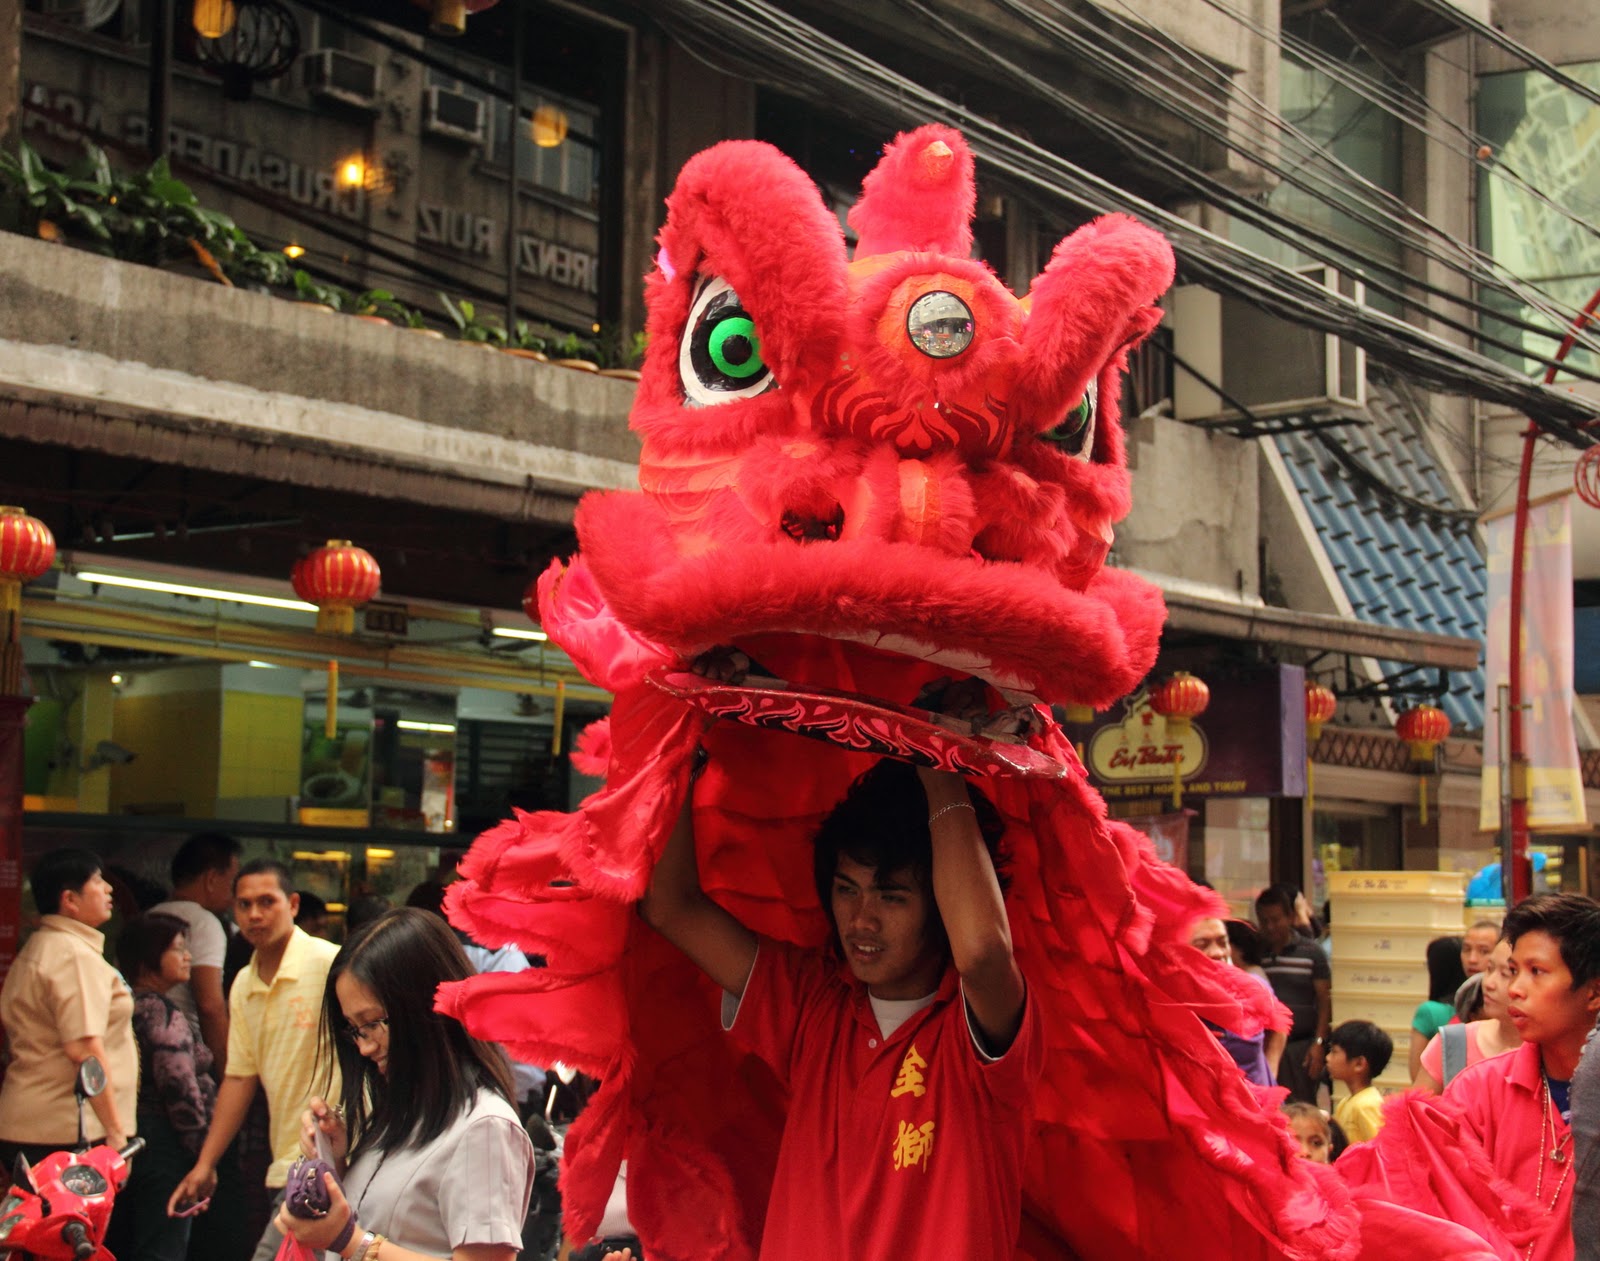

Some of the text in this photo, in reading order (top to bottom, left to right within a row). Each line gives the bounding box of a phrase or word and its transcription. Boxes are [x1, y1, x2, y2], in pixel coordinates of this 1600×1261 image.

[1123, 784, 1151, 796] BEST
[1153, 783, 1185, 795] HOPA
[1188, 782, 1211, 793] AND
